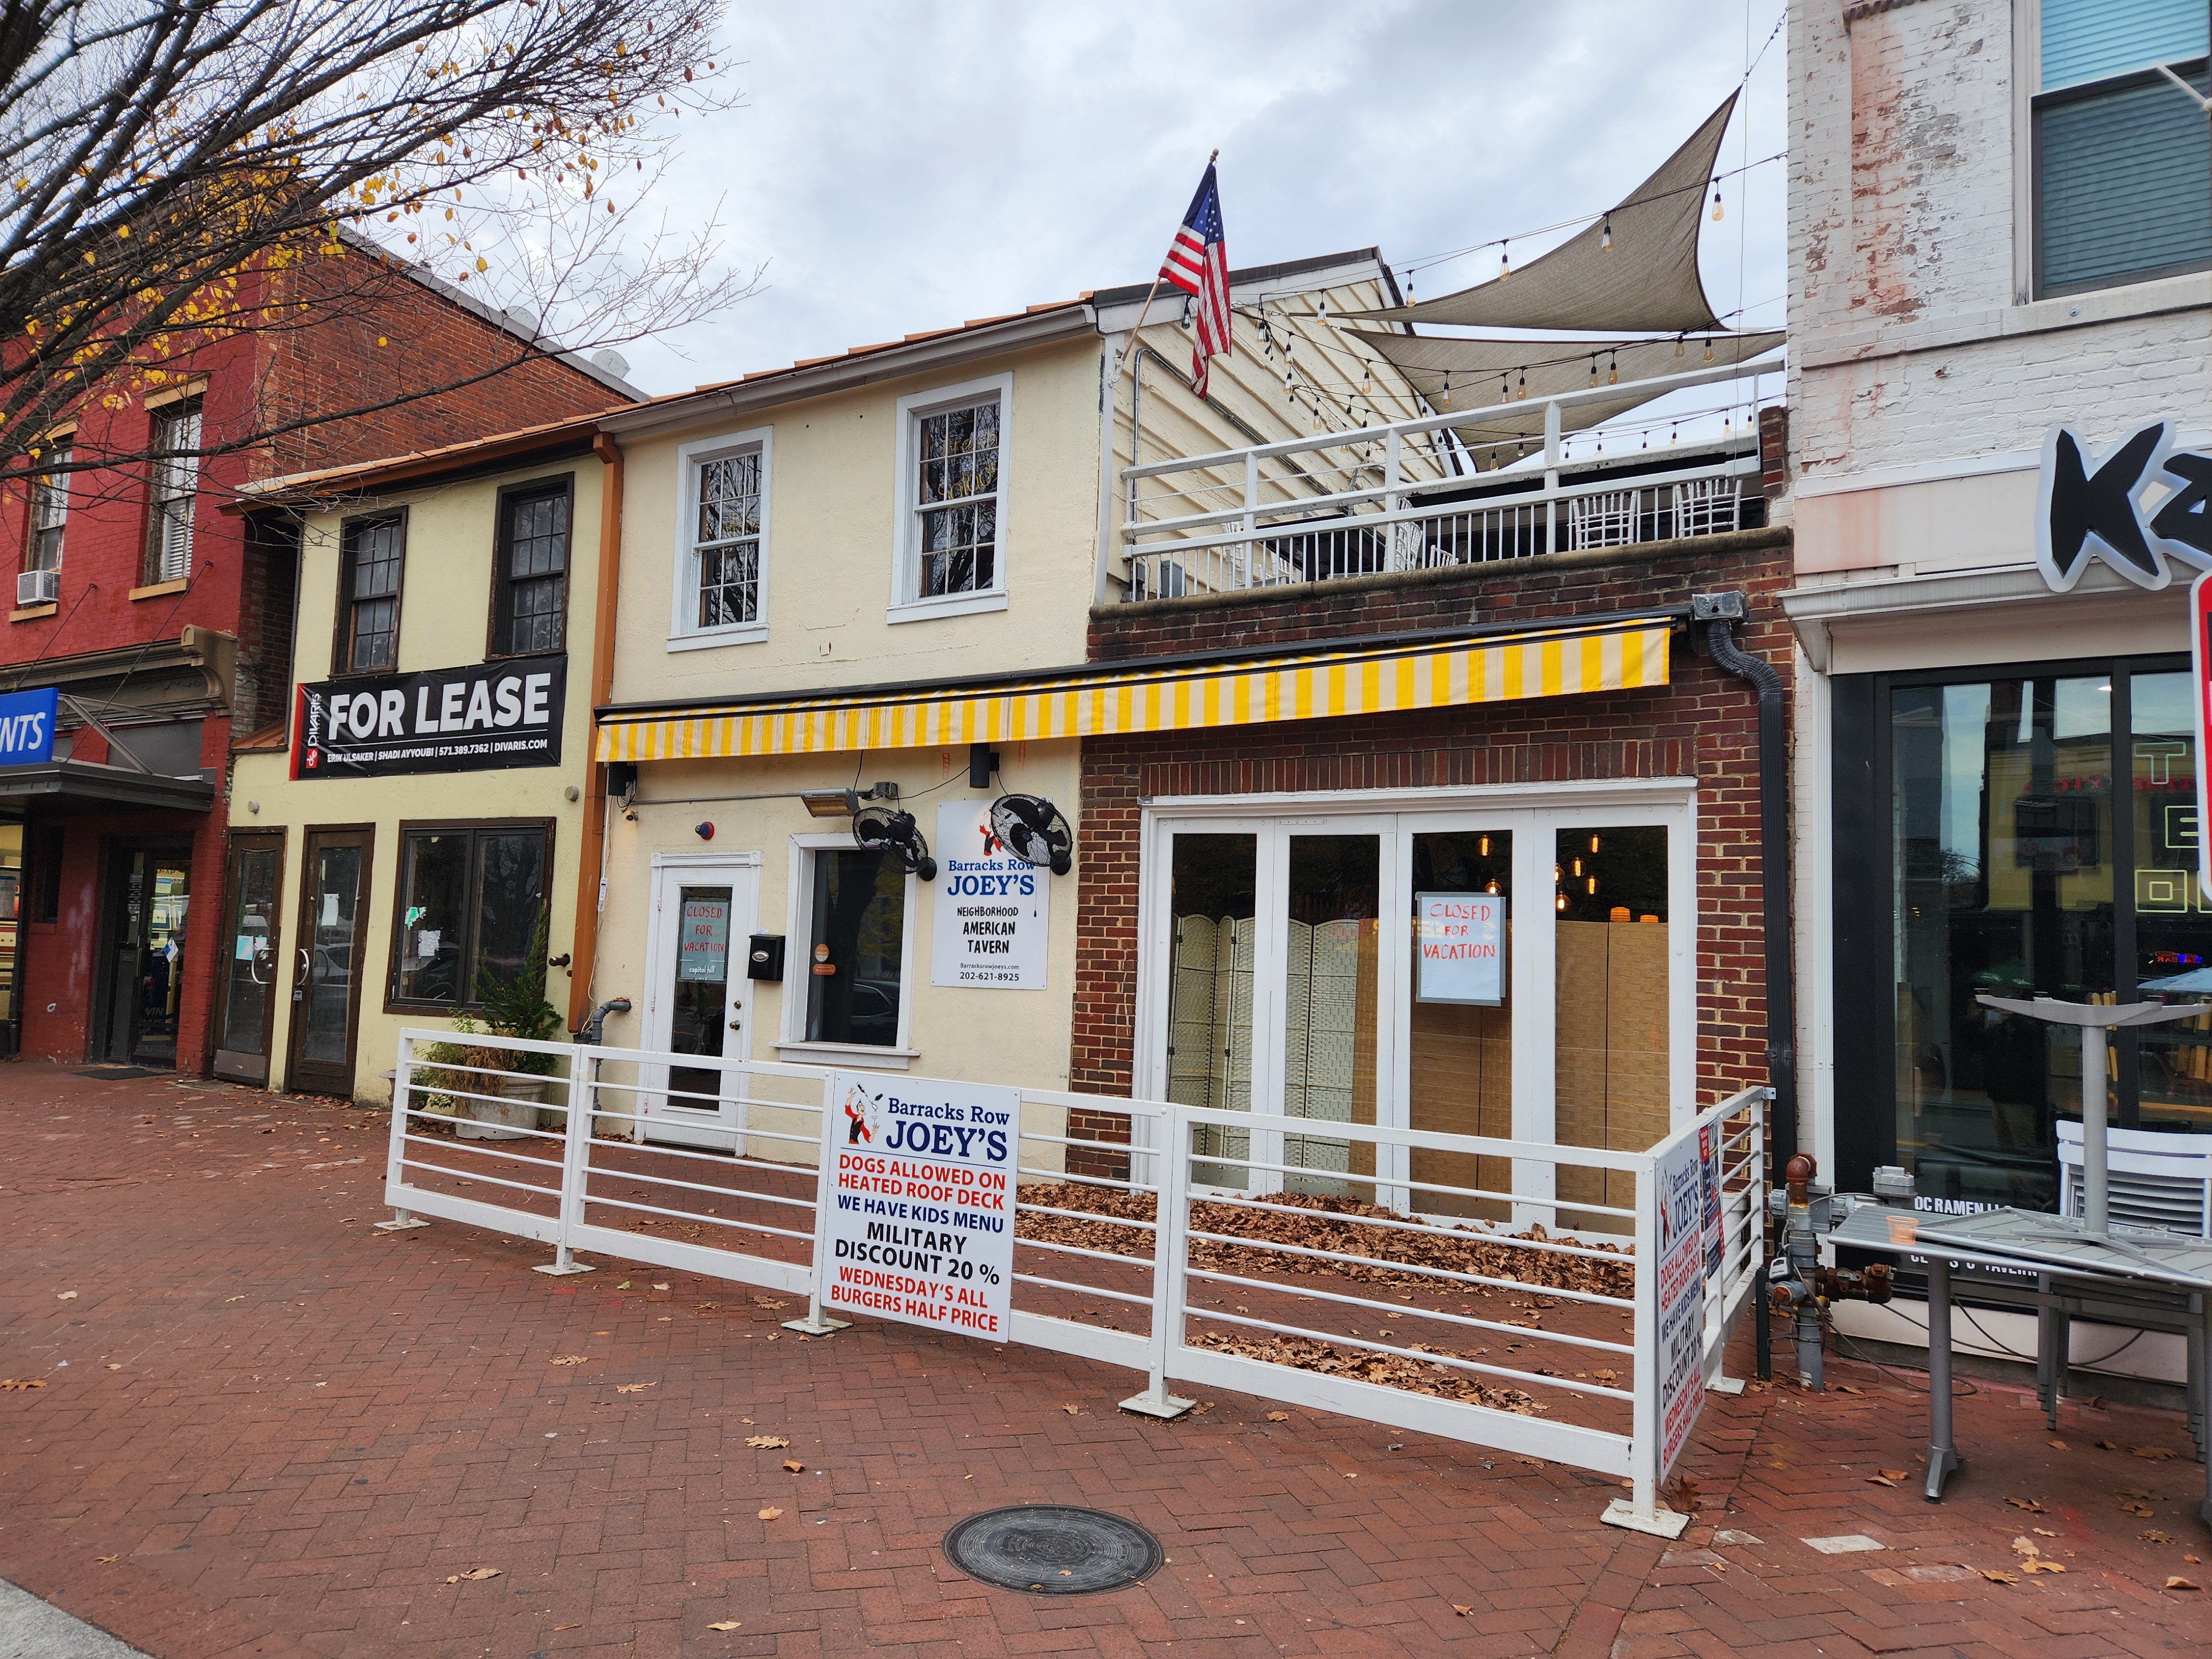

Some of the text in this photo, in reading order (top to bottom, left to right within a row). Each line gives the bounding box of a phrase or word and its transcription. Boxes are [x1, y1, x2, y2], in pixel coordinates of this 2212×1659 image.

[308, 693, 321, 747] DIVARIS
[328, 689, 405, 740] FOR
[415, 673, 551, 734] LEASE
[0, 712, 46, 753] NTS
[378, 749, 400, 760] SHADI
[401, 747, 434, 758] AYYOUBI
[439, 744, 488, 756] 571.389.7362
[494, 739, 547, 752] DIVARIS.COM
[948, 859, 1034, 871] Barracks Row
[947, 874, 1034, 896] JOEY'S
[687, 906, 722, 919] CLOSED
[957, 906, 1019, 917] NEIGHBORHOOD
[963, 921, 1015, 936] AMERICAN
[1430, 904, 1490, 921] CLOSED
[684, 942, 724, 952] VACATION
[695, 925, 712, 936] FOR
[968, 940, 1009, 954] TAVERN
[1444, 925, 1469, 936] FOR
[1423, 943, 1496, 959] VACATION
[689, 965, 715, 974] capitol hill
[959, 972, 1019, 981] 202-621-8925
[888, 1098, 1010, 1125] Barracks Row
[886, 1120, 1008, 1161] JOEY'S
[839, 1154, 1005, 1190] DOGS ALLOWED ON
[1673, 1164, 1689, 1196] Barracks
[838, 1173, 1004, 1211] HEATED ROOF DECK
[1914, 1196, 1983, 1215] DC RAMEN
[838, 1194, 1004, 1233] WE HAVE KIDS MENU
[1673, 1180, 1699, 1239] JOEY'S
[867, 1222, 967, 1255] MILITARY
[836, 1239, 1000, 1285] DISCOUNT 20 %
[1661, 1227, 1700, 1290] DOGS ALLOWED ON
[839, 1266, 988, 1308] WEDNESDAY'S ALL
[1661, 1248, 1700, 1316] HEATED ROOF DECK
[831, 1285, 998, 1333] BURGERS HALF PRICE
[1662, 1274, 1700, 1344] WE HAVE KIDS MENU
[1671, 1310, 1694, 1366] MILITARY
[1663, 1344, 1690, 1410] DISCOUNT
[1691, 1337, 1697, 1364] 20
[1665, 1373, 1693, 1438] WEDNESDAY'S
[1663, 1381, 1703, 1470] BURGERS HALF PRICE
